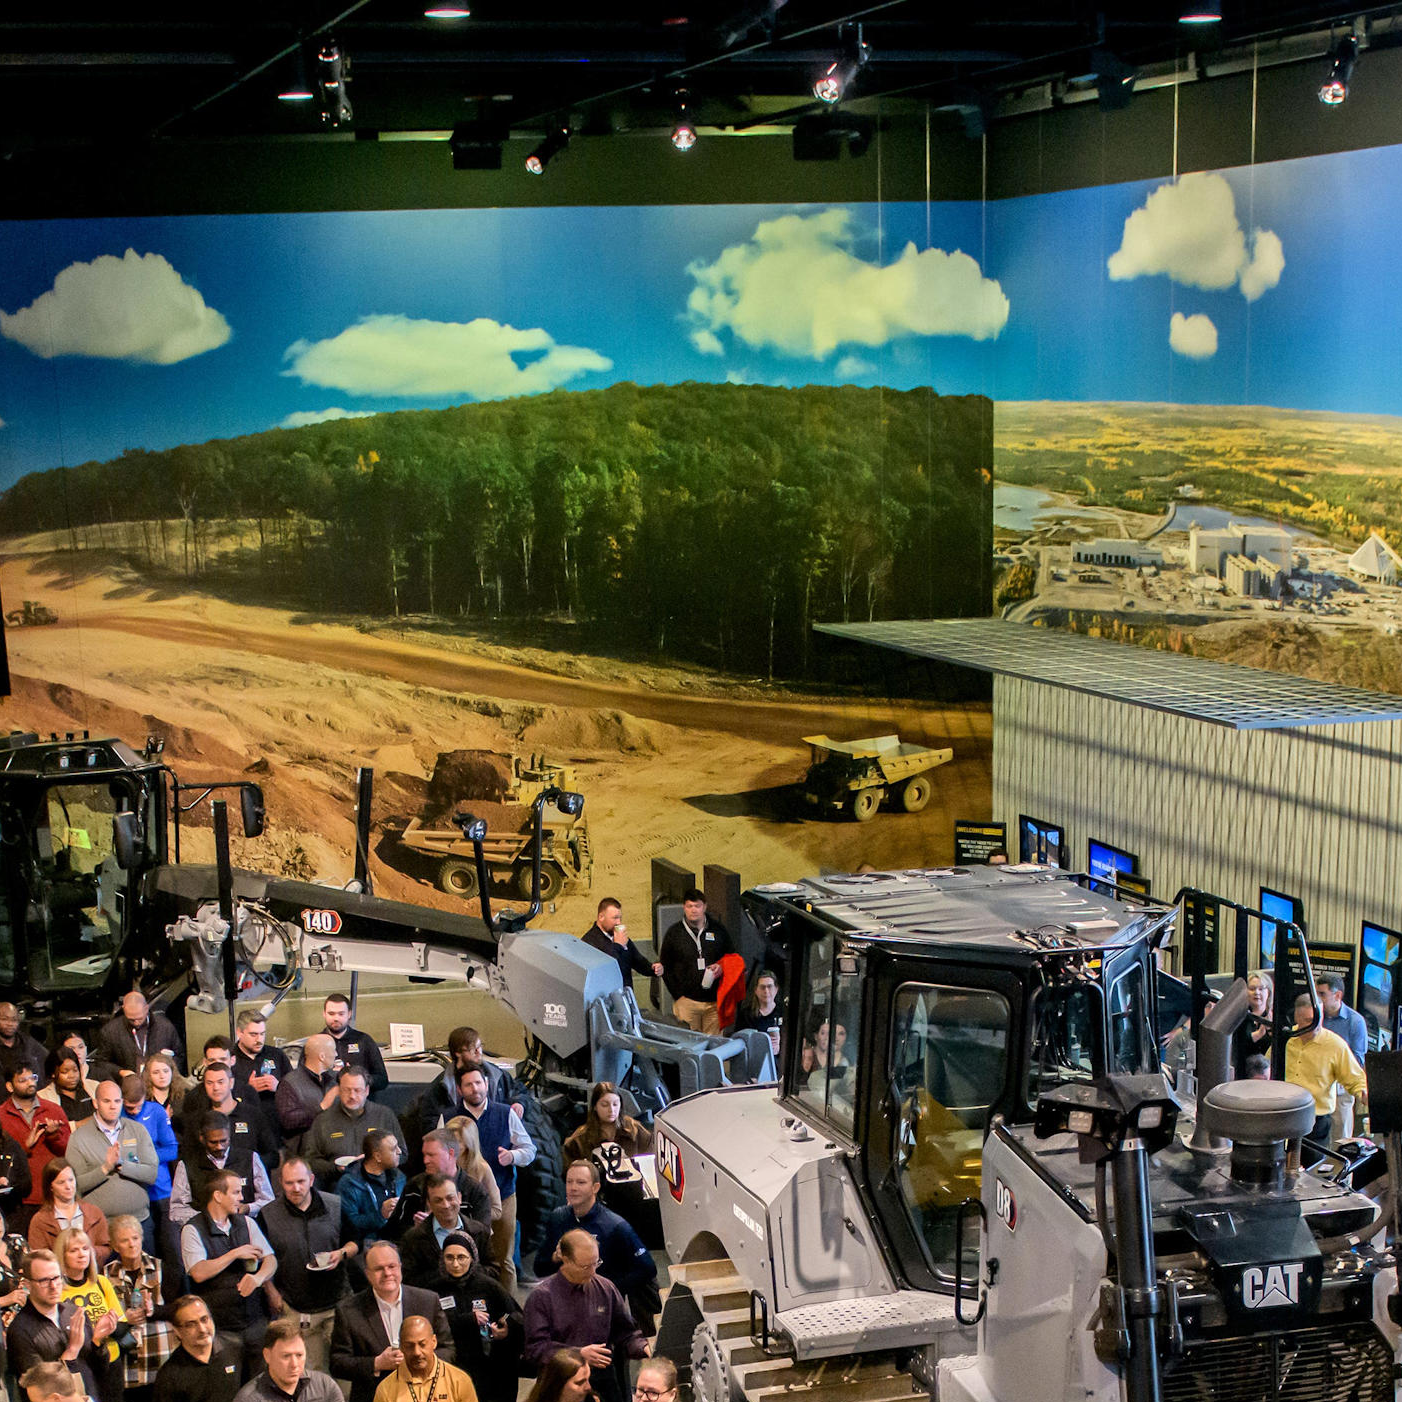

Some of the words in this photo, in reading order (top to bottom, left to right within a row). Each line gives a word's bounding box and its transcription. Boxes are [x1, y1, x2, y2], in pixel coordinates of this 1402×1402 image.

[303, 911, 333, 932] 140
[544, 1003, 566, 1014] 100
[658, 1132, 677, 1186] CAT
[997, 1179, 1011, 1223] D8
[1243, 1264, 1303, 1308] CAT
